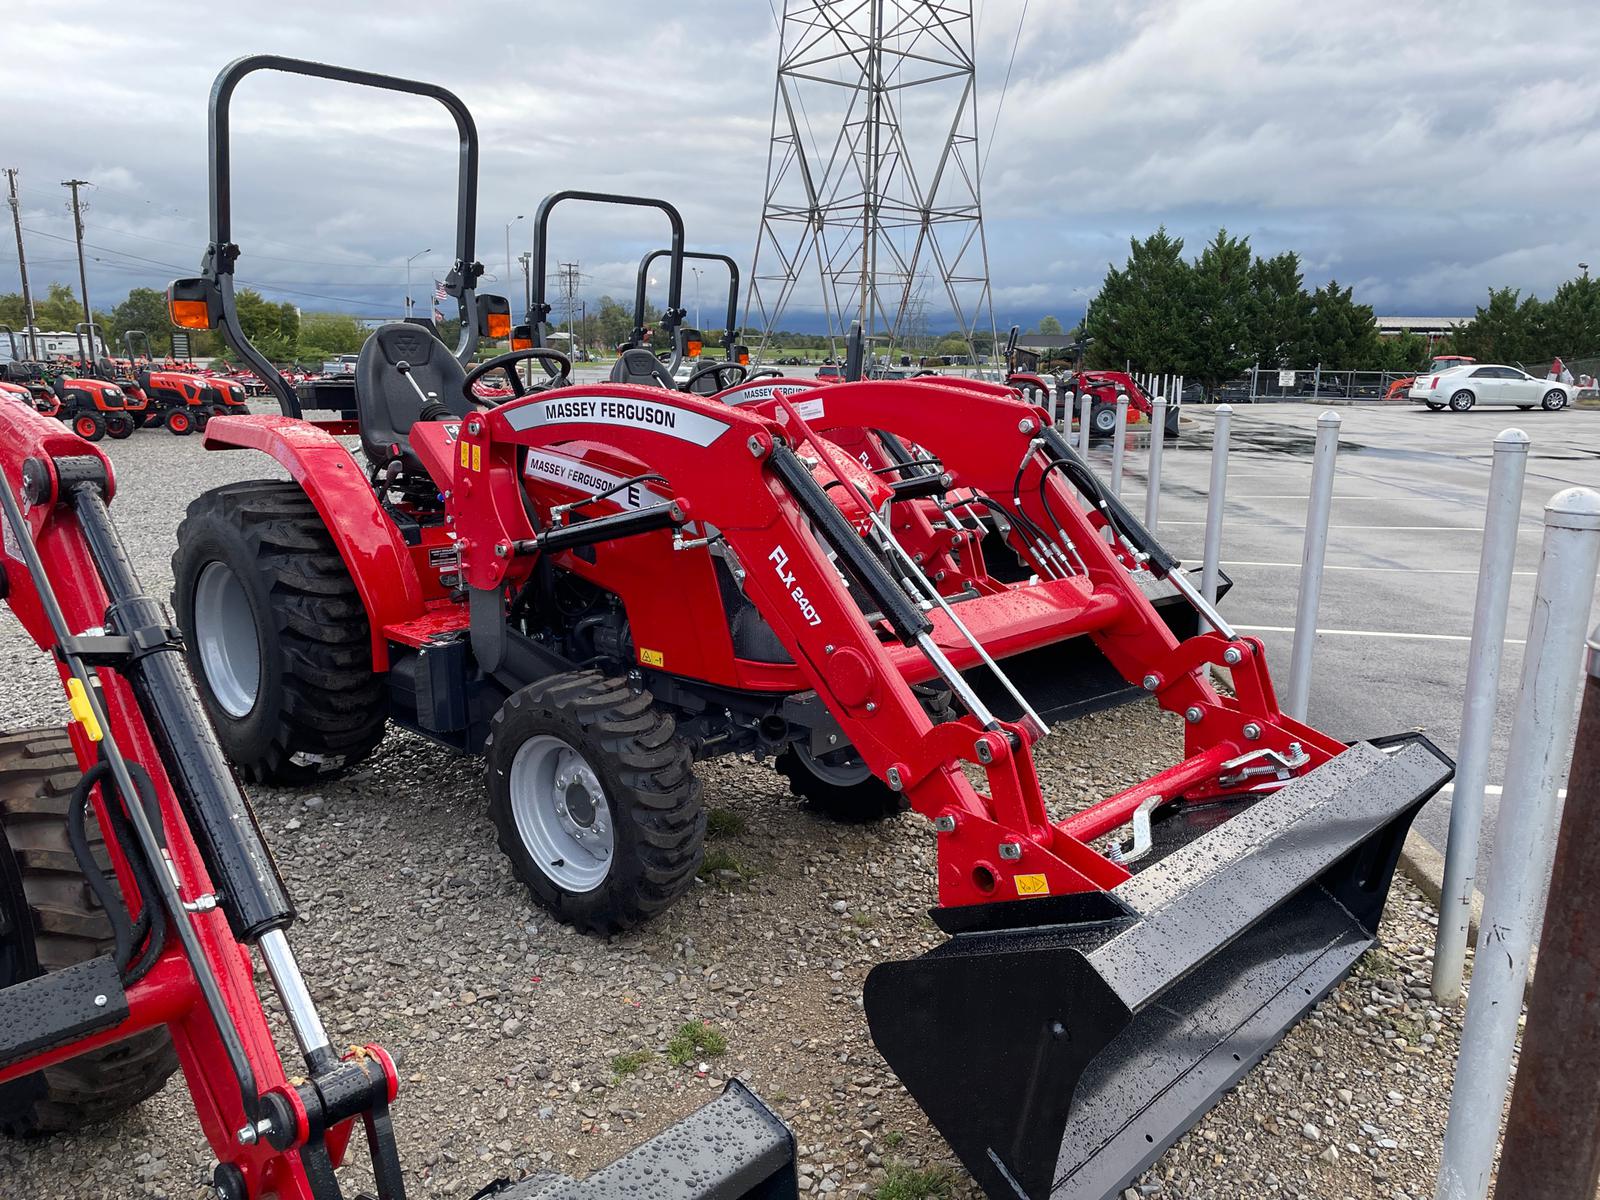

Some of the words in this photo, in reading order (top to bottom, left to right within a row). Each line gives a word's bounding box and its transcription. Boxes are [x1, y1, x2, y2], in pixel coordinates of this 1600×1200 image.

[744, 388, 772, 399] MASSEY
[545, 402, 597, 420] MASSEY
[601, 402, 676, 428] FERGUSON
[530, 458, 566, 478] MASSEY
[567, 468, 616, 492] FERGUSON
[628, 486, 640, 508] E
[791, 586, 822, 626] 2407
